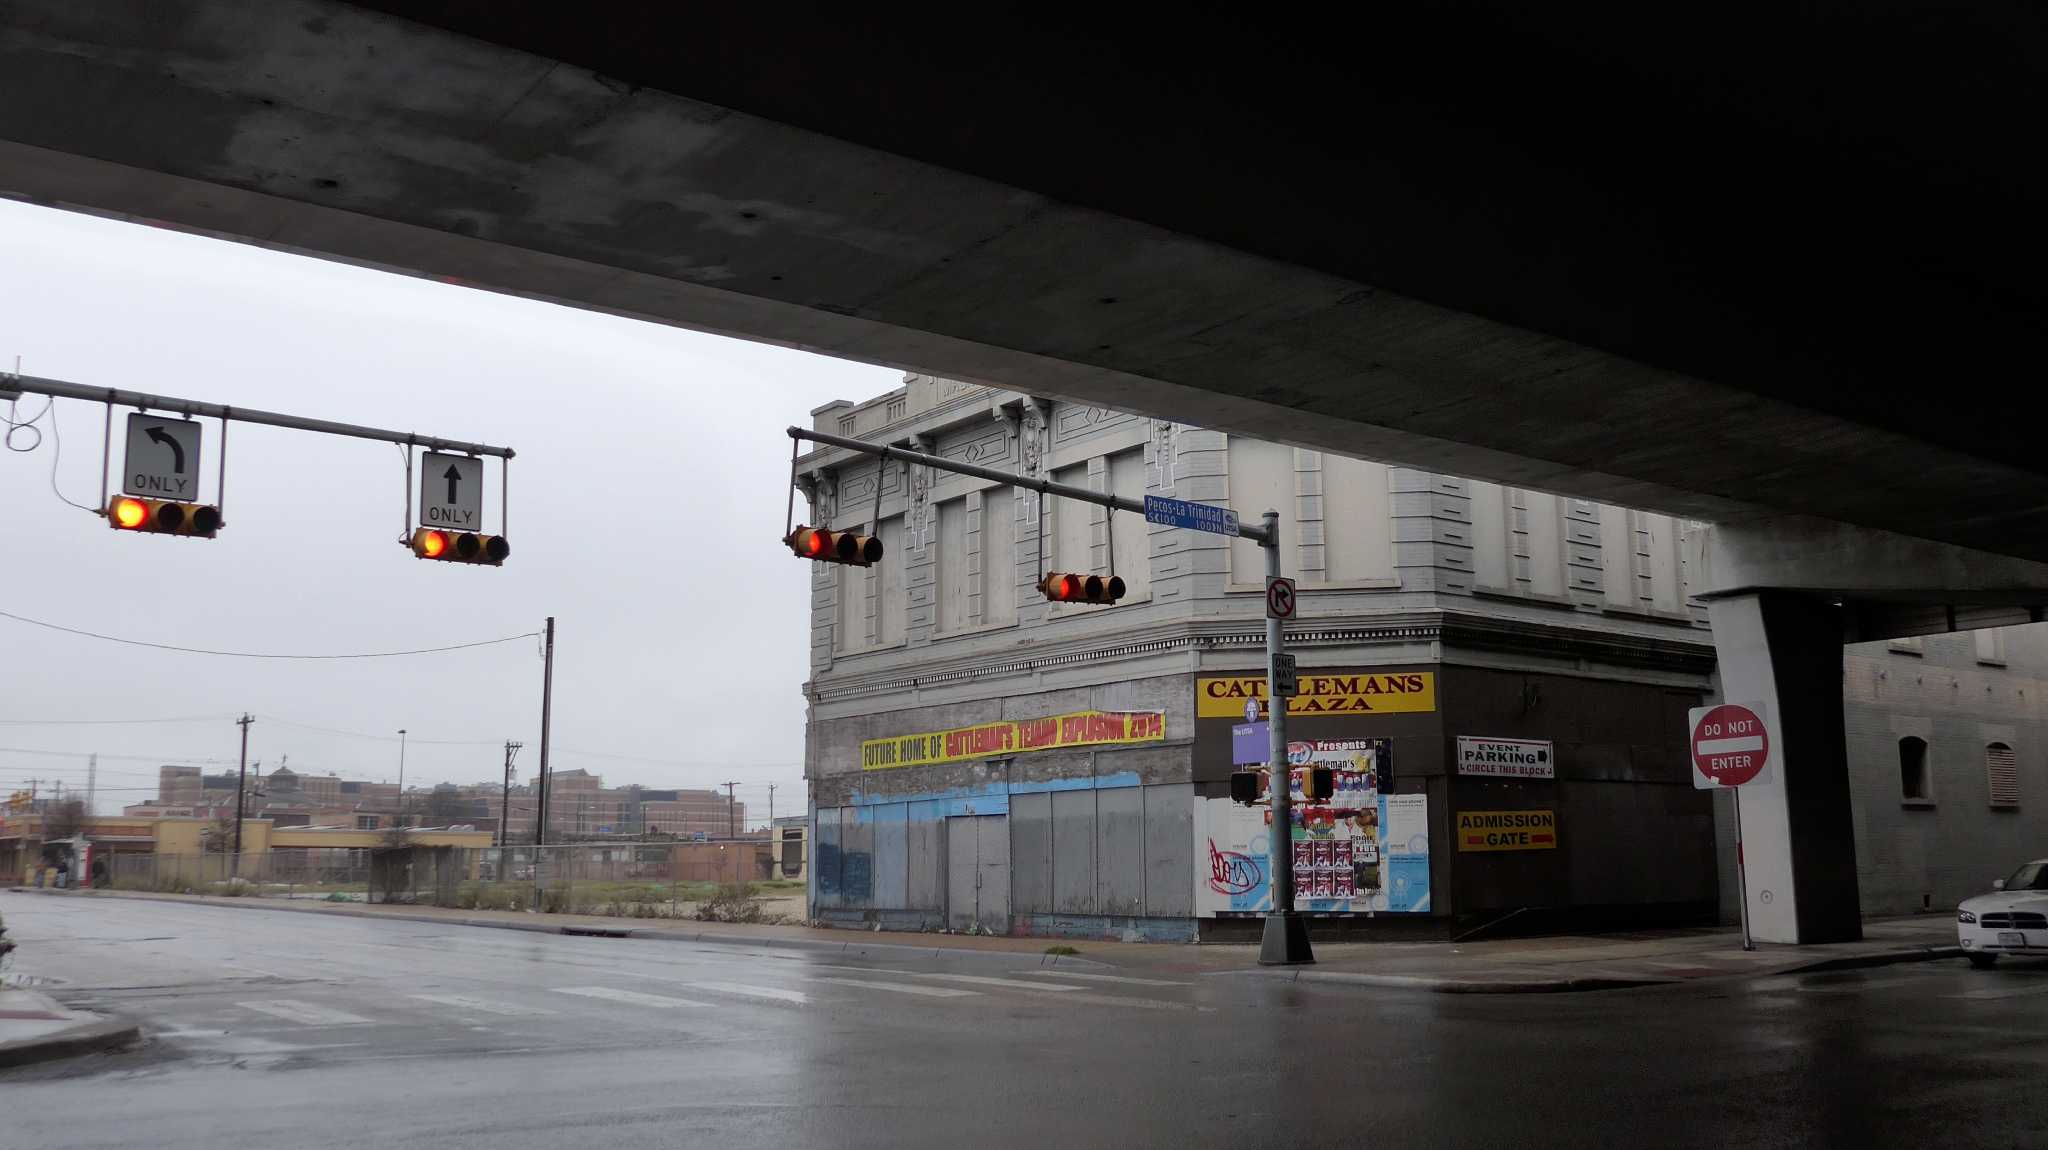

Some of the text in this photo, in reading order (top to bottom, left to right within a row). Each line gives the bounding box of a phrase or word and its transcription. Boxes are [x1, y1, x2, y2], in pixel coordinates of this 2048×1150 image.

[135, 473, 188, 494] ONLY
[429, 506, 473, 524] ONLY
[1147, 497, 1221, 522] Pecos-La Trinidad
[1275, 656, 1293, 669] ONE
[1275, 669, 1293, 681] WAY
[1206, 674, 1425, 698] CATLEMANS
[1704, 720, 1753, 736] DO NOT
[864, 741, 897, 767] FUTURE
[900, 736, 926, 762] HOME
[930, 735, 942, 759] OF
[1018, 718, 1057, 748] TEJANO
[1061, 711, 1125, 743] EXPLOSION
[1316, 740, 1367, 751] Presents
[1478, 743, 1521, 752] EVENT
[1464, 750, 1536, 764] PARKING
[1711, 755, 1752, 770] ENTER
[1466, 763, 1545, 776] CIRCLE THIS BLOCK
[1461, 814, 1553, 829] ADMISSION
[1487, 832, 1529, 846] GATE
